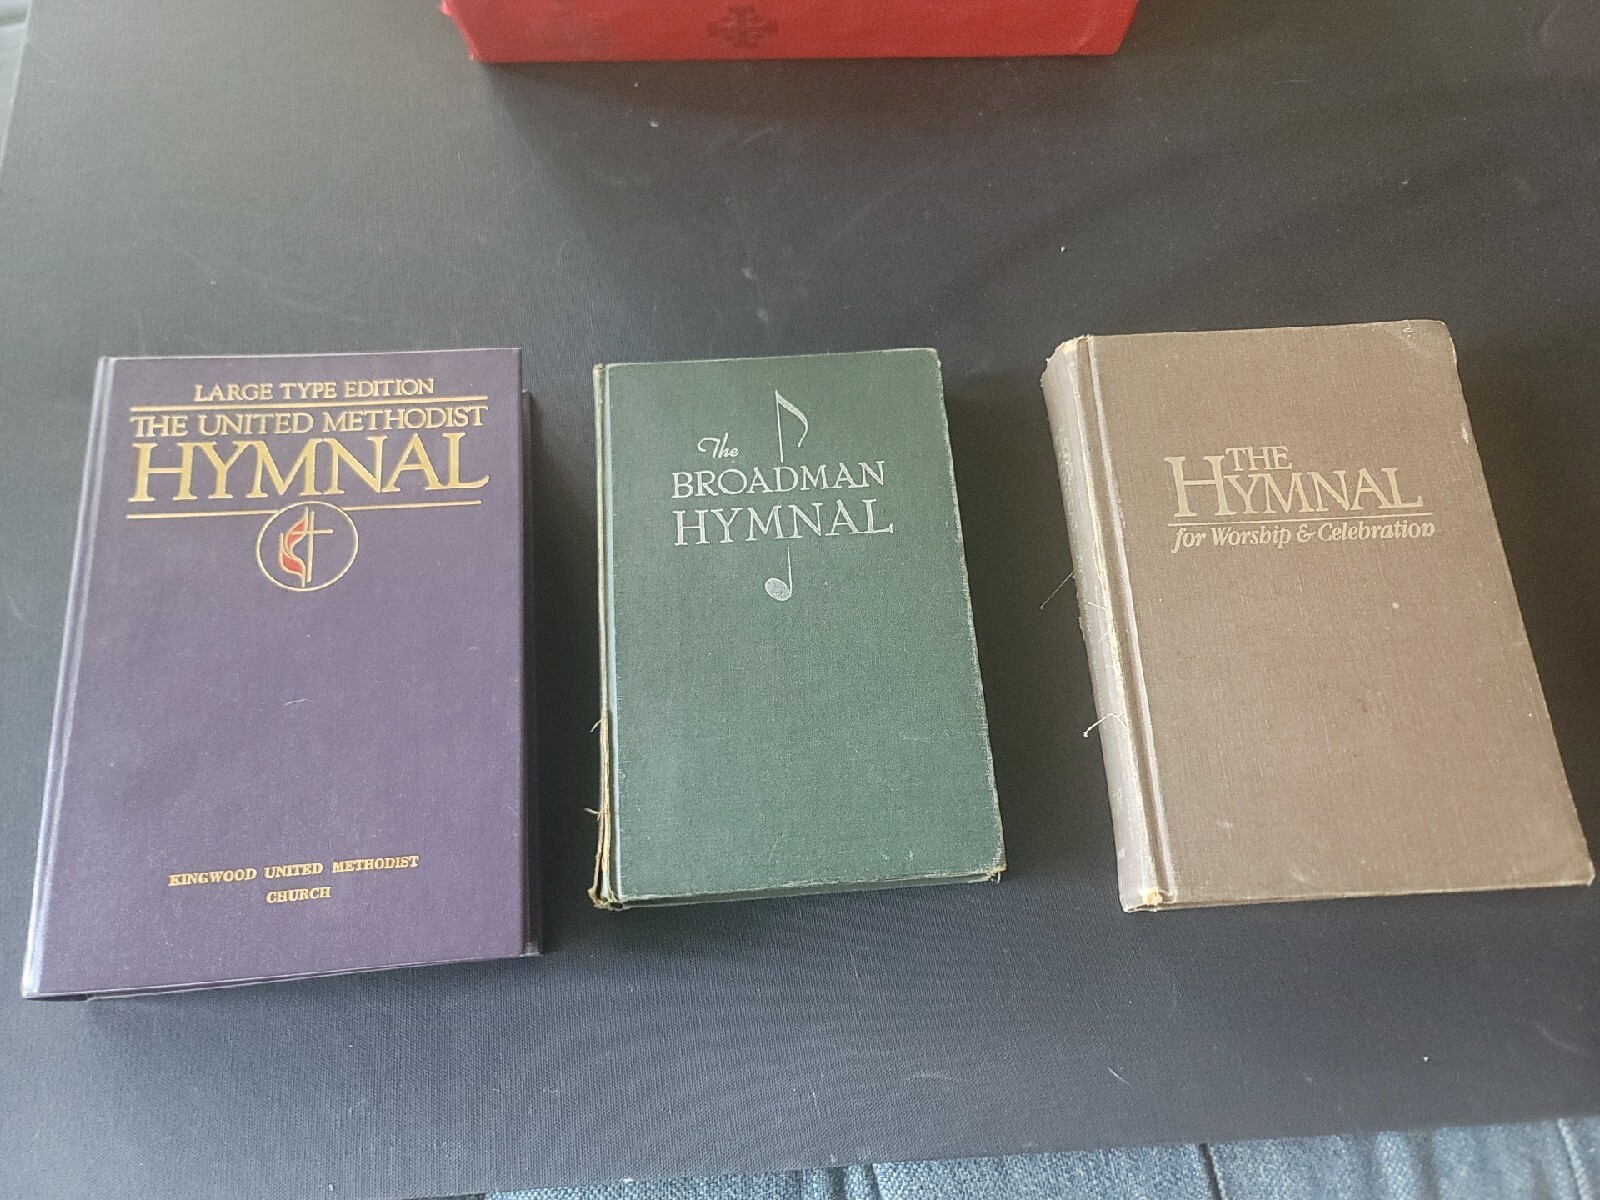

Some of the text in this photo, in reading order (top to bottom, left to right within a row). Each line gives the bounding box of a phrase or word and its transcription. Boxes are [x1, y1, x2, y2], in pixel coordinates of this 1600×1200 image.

[194, 378, 435, 401] LARGE TYPE EDITION
[129, 405, 489, 438] THE UNITED METHODIST
[697, 432, 740, 459] The
[1225, 445, 1293, 472] THE
[128, 431, 490, 502] HYMNAL
[671, 460, 885, 499] BROADMAN
[1163, 455, 1424, 518] HYMNAL
[672, 498, 894, 546] HYMNAL
[1170, 519, 1436, 554] for Worship & Celebration
[168, 855, 419, 887] KINGWOOD UNITED METHODIST
[266, 886, 332, 904] CHURCH
